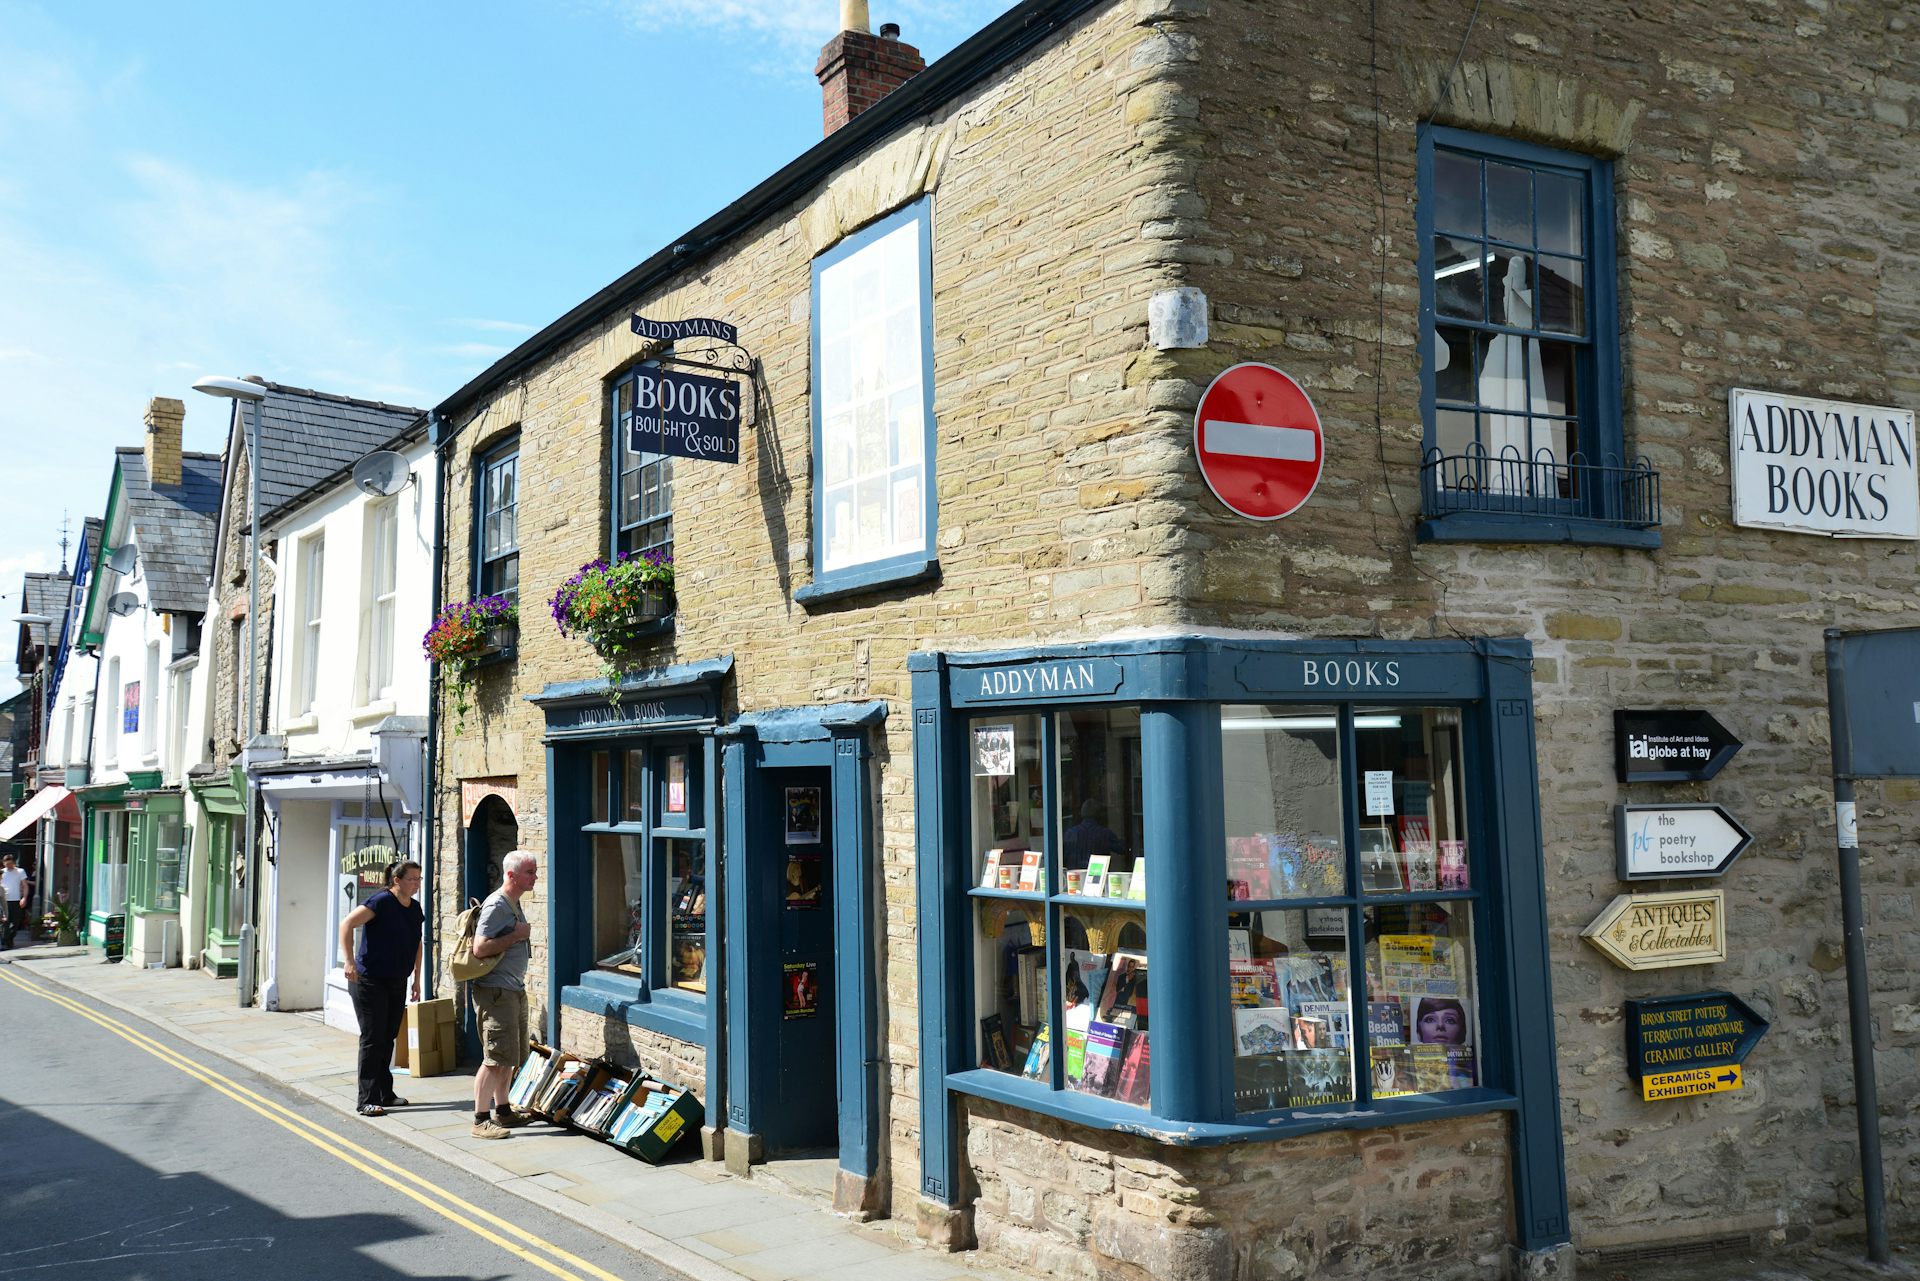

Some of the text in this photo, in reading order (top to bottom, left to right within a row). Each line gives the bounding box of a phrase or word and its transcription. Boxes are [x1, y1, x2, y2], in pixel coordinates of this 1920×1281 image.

[636, 318, 732, 340] ADDYMANS
[636, 375, 736, 421] BOOKS
[636, 416, 736, 456] BOUGHT & SOLD
[1739, 402, 1912, 469] ADDYMAN
[1766, 464, 1889, 522] BOOKS
[980, 663, 1094, 696] ADDYMAN
[1303, 660, 1400, 686] BOOKS
[634, 701, 666, 720] BOOKS
[1629, 734, 1648, 758] iai
[1648, 735, 1669, 743] Institute
[1669, 735, 1675, 743] of
[1648, 745, 1712, 760] globe at hay
[1658, 813, 1675, 826] the
[1659, 833, 1697, 850] poetry
[341, 851, 357, 875] THE
[358, 844, 393, 868] CUTTING
[1660, 851, 1714, 867] bookshop
[1630, 903, 1712, 928] ANTIQUES
[1628, 924, 1712, 953] & Collectables
[1304, 1004, 1330, 1012] DENIM
[1640, 1004, 1728, 1026] BROOK STREET POTTERY
[1368, 1020, 1399, 1034] Beach
[1642, 1020, 1745, 1044] TERRACOTTA GARDENWARE
[1376, 1036, 1401, 1047] Boys
[1644, 1038, 1737, 1065] CERAMICS GALLERY
[1651, 1070, 1711, 1086] CERAMICS
[1648, 1081, 1716, 1099] EXHIBITION
